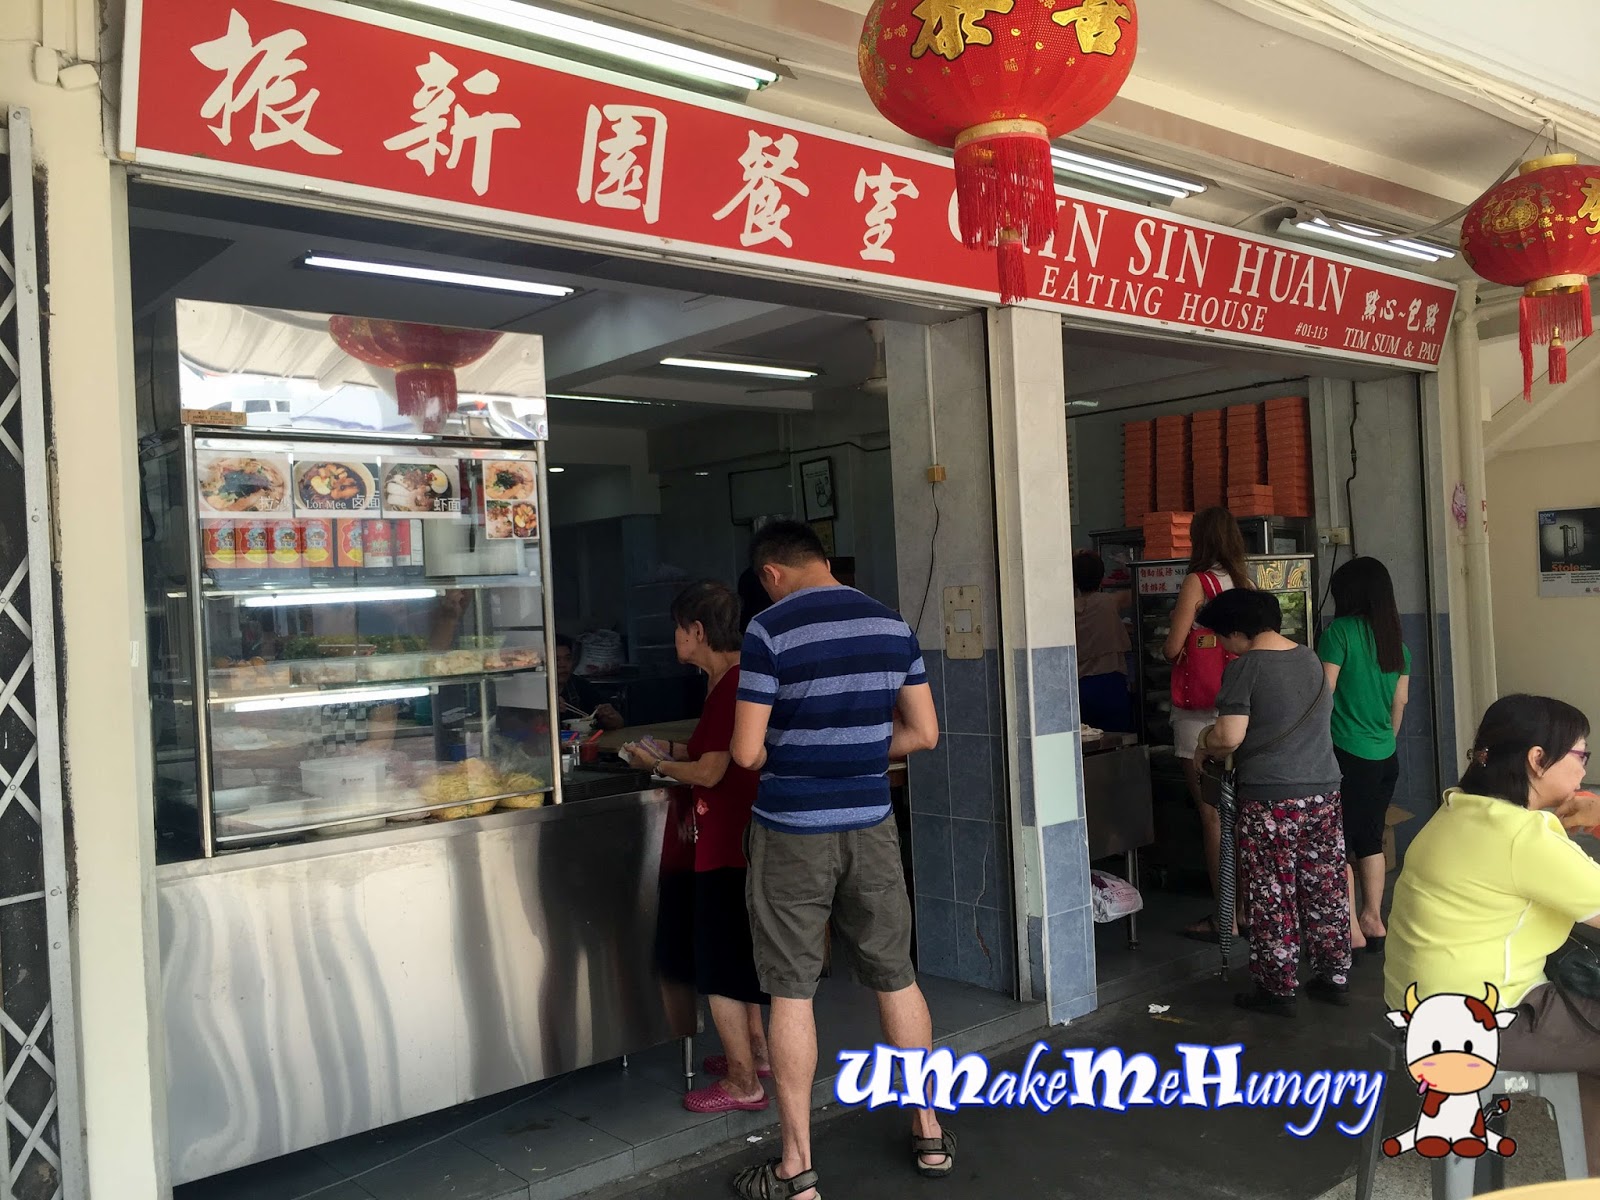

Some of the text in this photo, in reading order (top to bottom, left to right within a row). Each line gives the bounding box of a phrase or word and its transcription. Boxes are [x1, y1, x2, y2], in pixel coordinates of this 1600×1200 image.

[1128, 217, 1215, 288] SIN
[1229, 240, 1352, 315] HUAN
[1039, 265, 1268, 333] EATING HOUSE
[1295, 321, 1328, 341] #01-113
[1343, 327, 1440, 361] TIM SUM & PAU
[306, 499, 323, 510] Lor
[326, 499, 347, 510] Mee
[434, 497, 461, 512] 虾面
